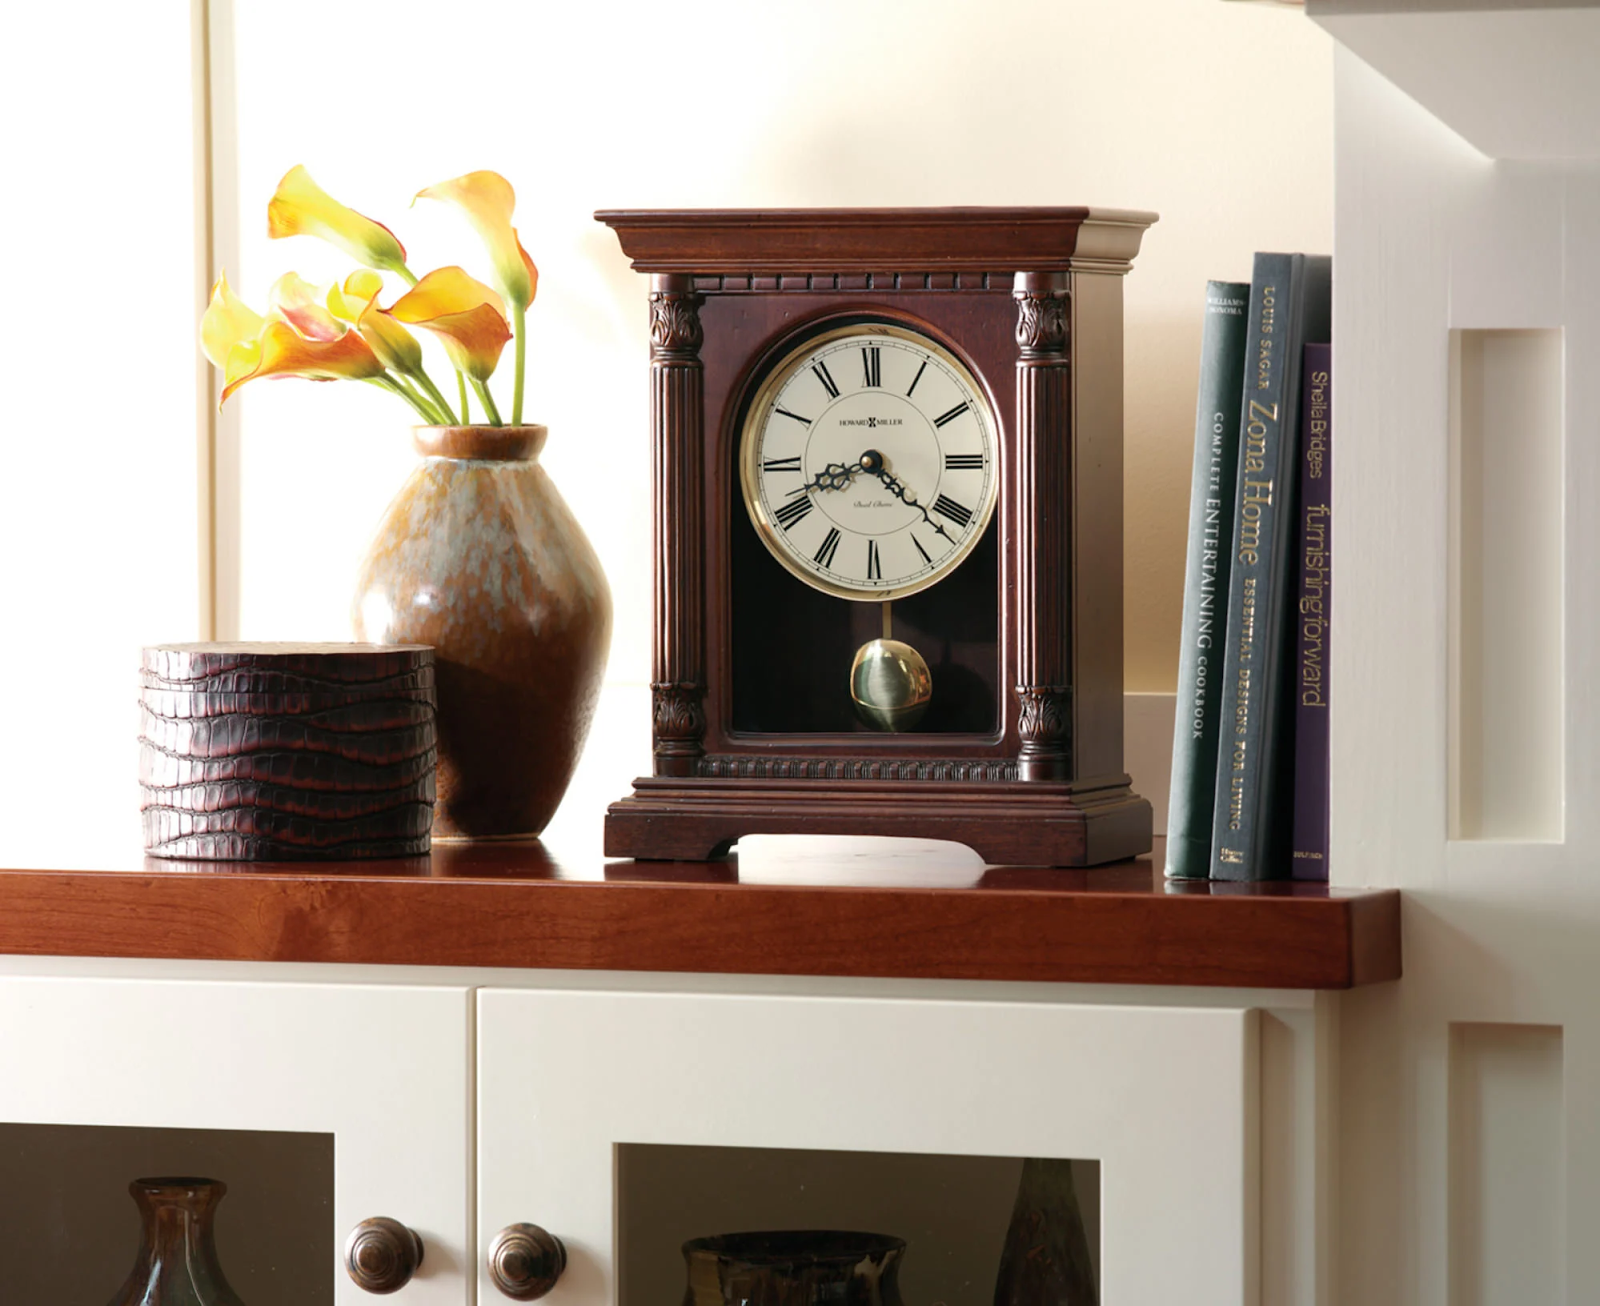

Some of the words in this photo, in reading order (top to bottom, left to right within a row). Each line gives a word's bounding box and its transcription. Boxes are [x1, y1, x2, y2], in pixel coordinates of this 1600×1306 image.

[1262, 285, 1276, 334] LOUIS
[861, 347, 882, 388] XII
[1257, 339, 1273, 390] SAGAR
[839, 419, 869, 427] HOWARD
[876, 418, 903, 426] MILLER
[1310, 371, 1328, 418] Sheila
[1209, 412, 1225, 492] COMPLETE
[1244, 399, 1278, 474] Zona
[1306, 421, 1327, 479] Bridges
[1238, 478, 1274, 566] Home
[1196, 498, 1221, 649] ENTERTAINING
[1240, 578, 1257, 663] ESSENTIAL
[1192, 656, 1208, 739] COOKBOOK
[1235, 669, 1251, 735] DESIGNS
[1233, 741, 1247, 771] FOR
[1229, 777, 1244, 831] LIVING
